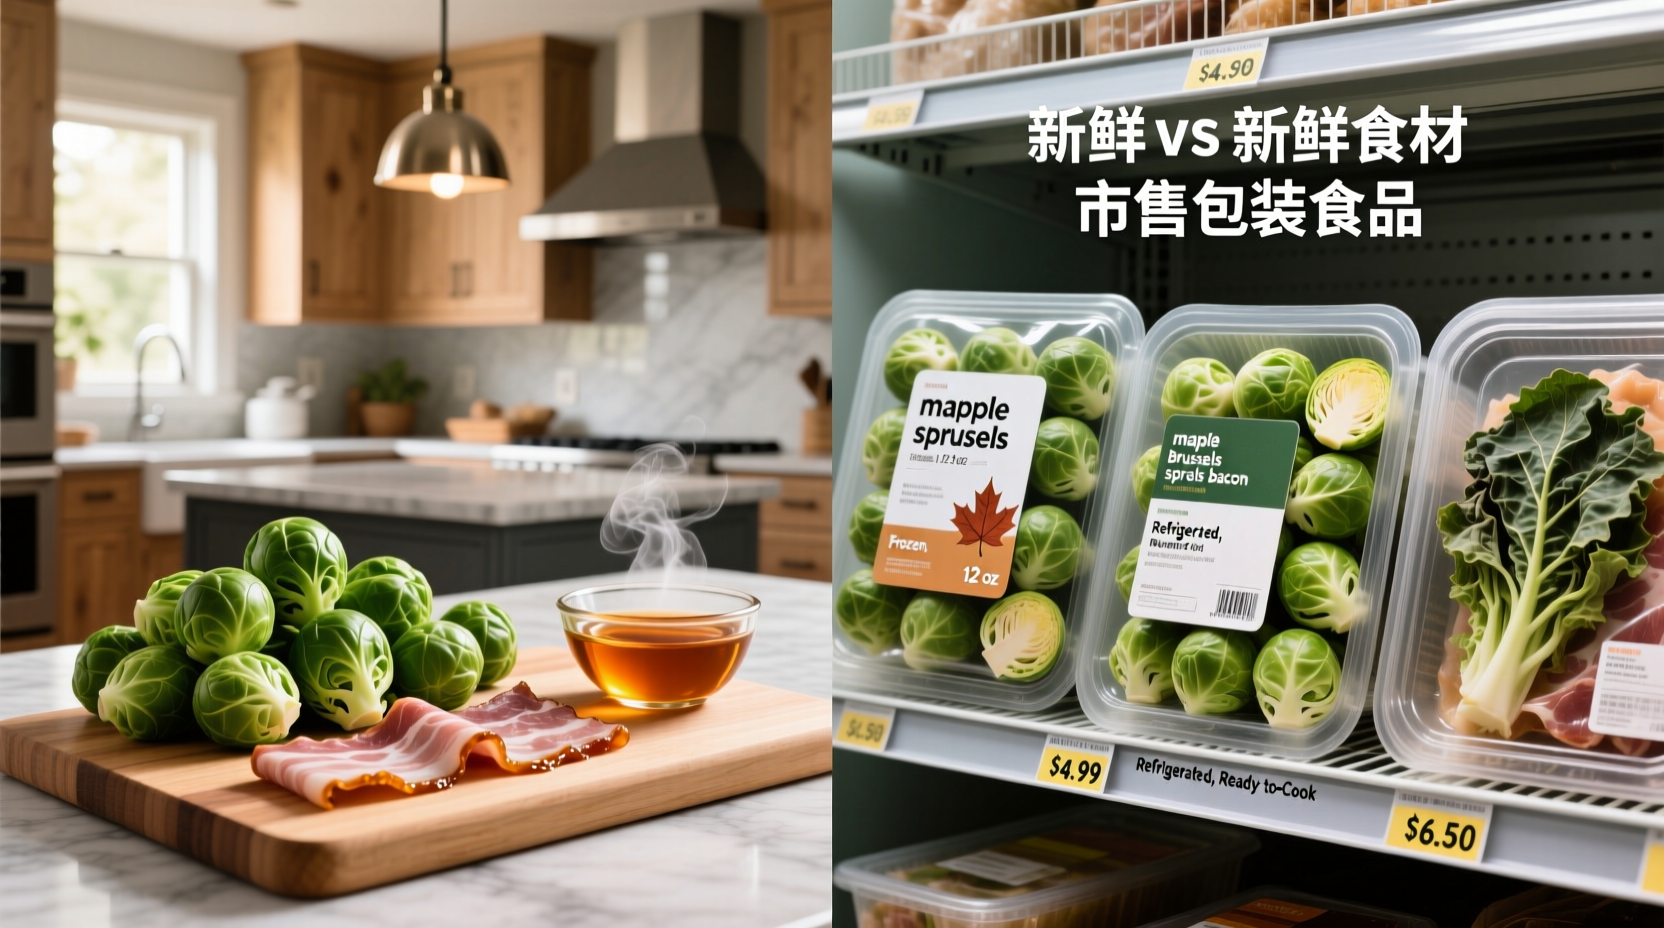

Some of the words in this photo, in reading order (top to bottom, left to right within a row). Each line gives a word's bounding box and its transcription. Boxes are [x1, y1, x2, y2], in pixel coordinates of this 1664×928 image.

[1198, 57, 1254, 83] $4.90
[919, 396, 1010, 424] mapple
[912, 425, 1009, 450] sprusels
[1172, 432, 1220, 452] maple
[1167, 449, 1223, 466] Brussels
[1207, 467, 1249, 486] bacon
[963, 565, 980, 584] 12
[981, 572, 1000, 586] oz
[1049, 754, 1102, 785] $4.99
[1218, 770, 1261, 795] Ready
[1263, 778, 1317, 801] to-Cook
[1404, 813, 1477, 852] $6.50
